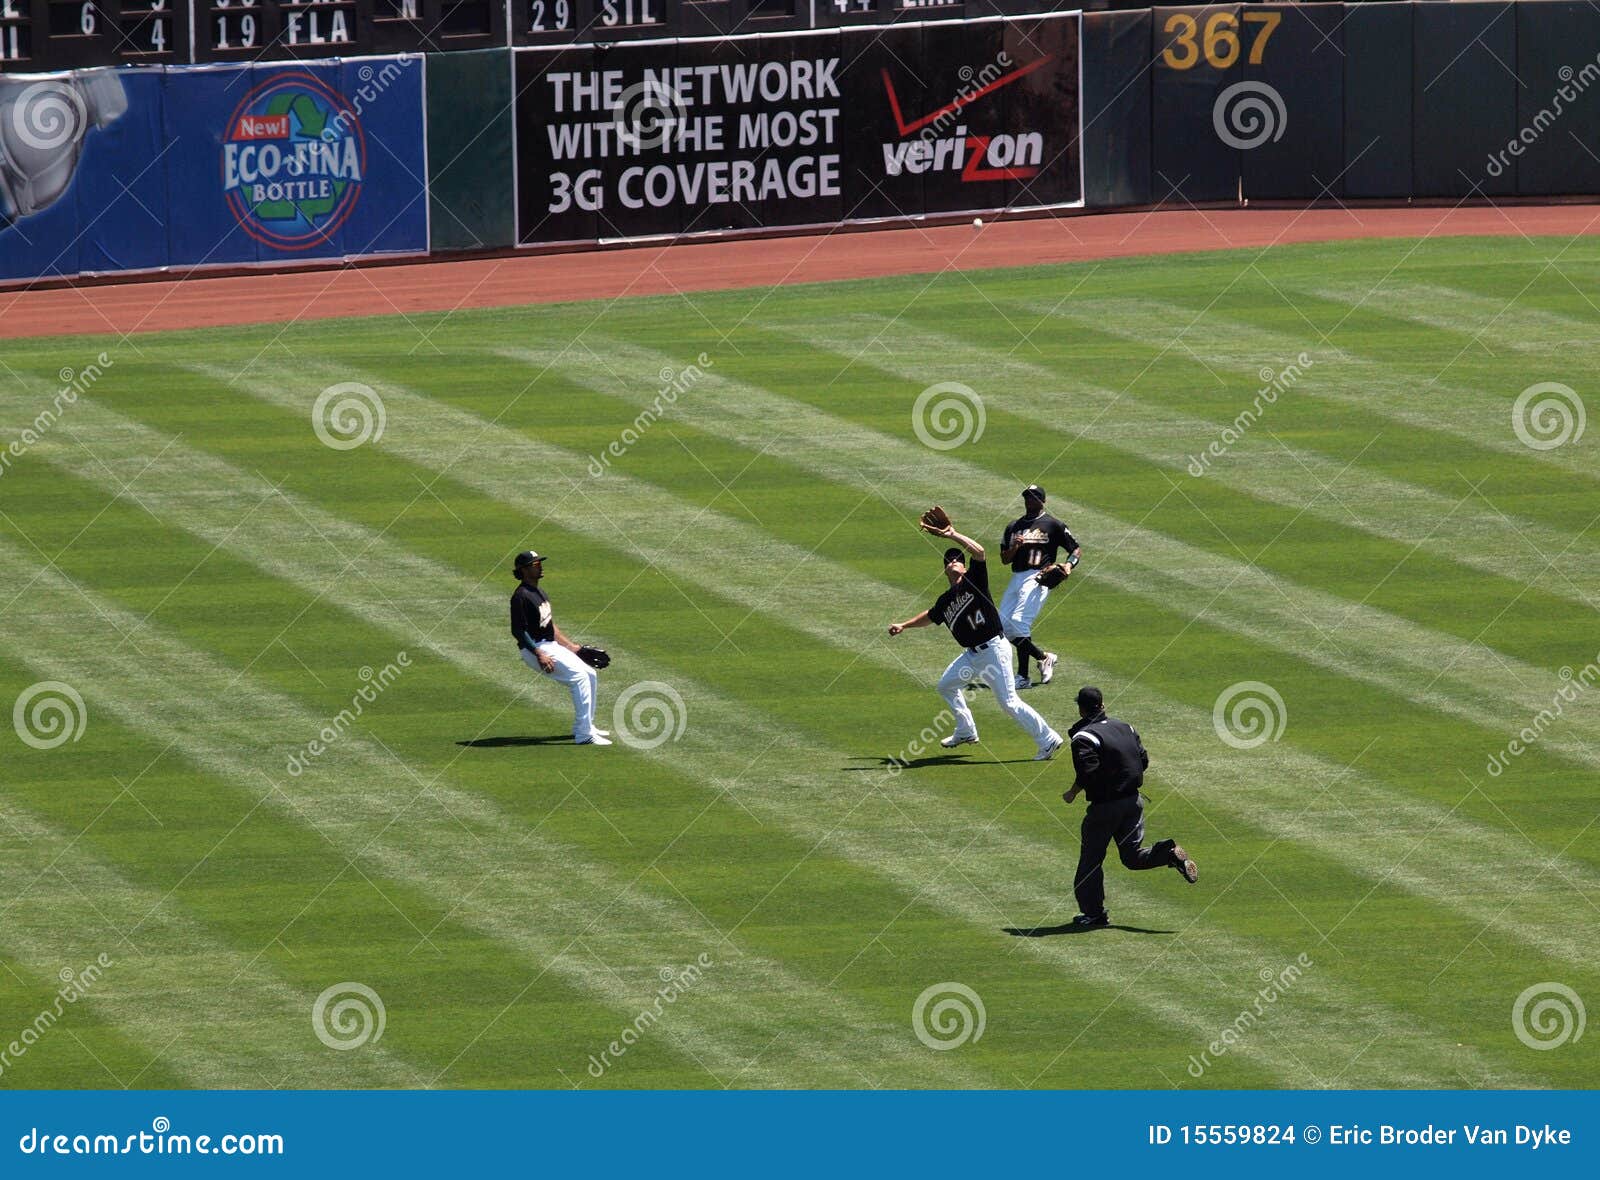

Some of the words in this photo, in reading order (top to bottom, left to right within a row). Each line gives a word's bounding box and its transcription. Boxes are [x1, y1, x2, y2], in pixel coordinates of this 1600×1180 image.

[81, 2, 95, 35] 6
[151, 18, 165, 51] 4
[217, 14, 256, 48] 19
[288, 10, 349, 44] FLA
[531, 0, 569, 31] 29
[1163, 12, 1281, 70] 367
[547, 70, 624, 112] THE
[643, 58, 840, 108] NETWORK
[240, 117, 286, 136] New!
[547, 120, 641, 160] WITH
[655, 115, 724, 153] THE
[738, 108, 840, 149] MOST
[883, 125, 1043, 182] verizon
[252, 180, 330, 202] BOTTLE
[548, 169, 604, 213] 3G
[618, 154, 840, 209] COVERAGE
[967, 608, 986, 630] 14
